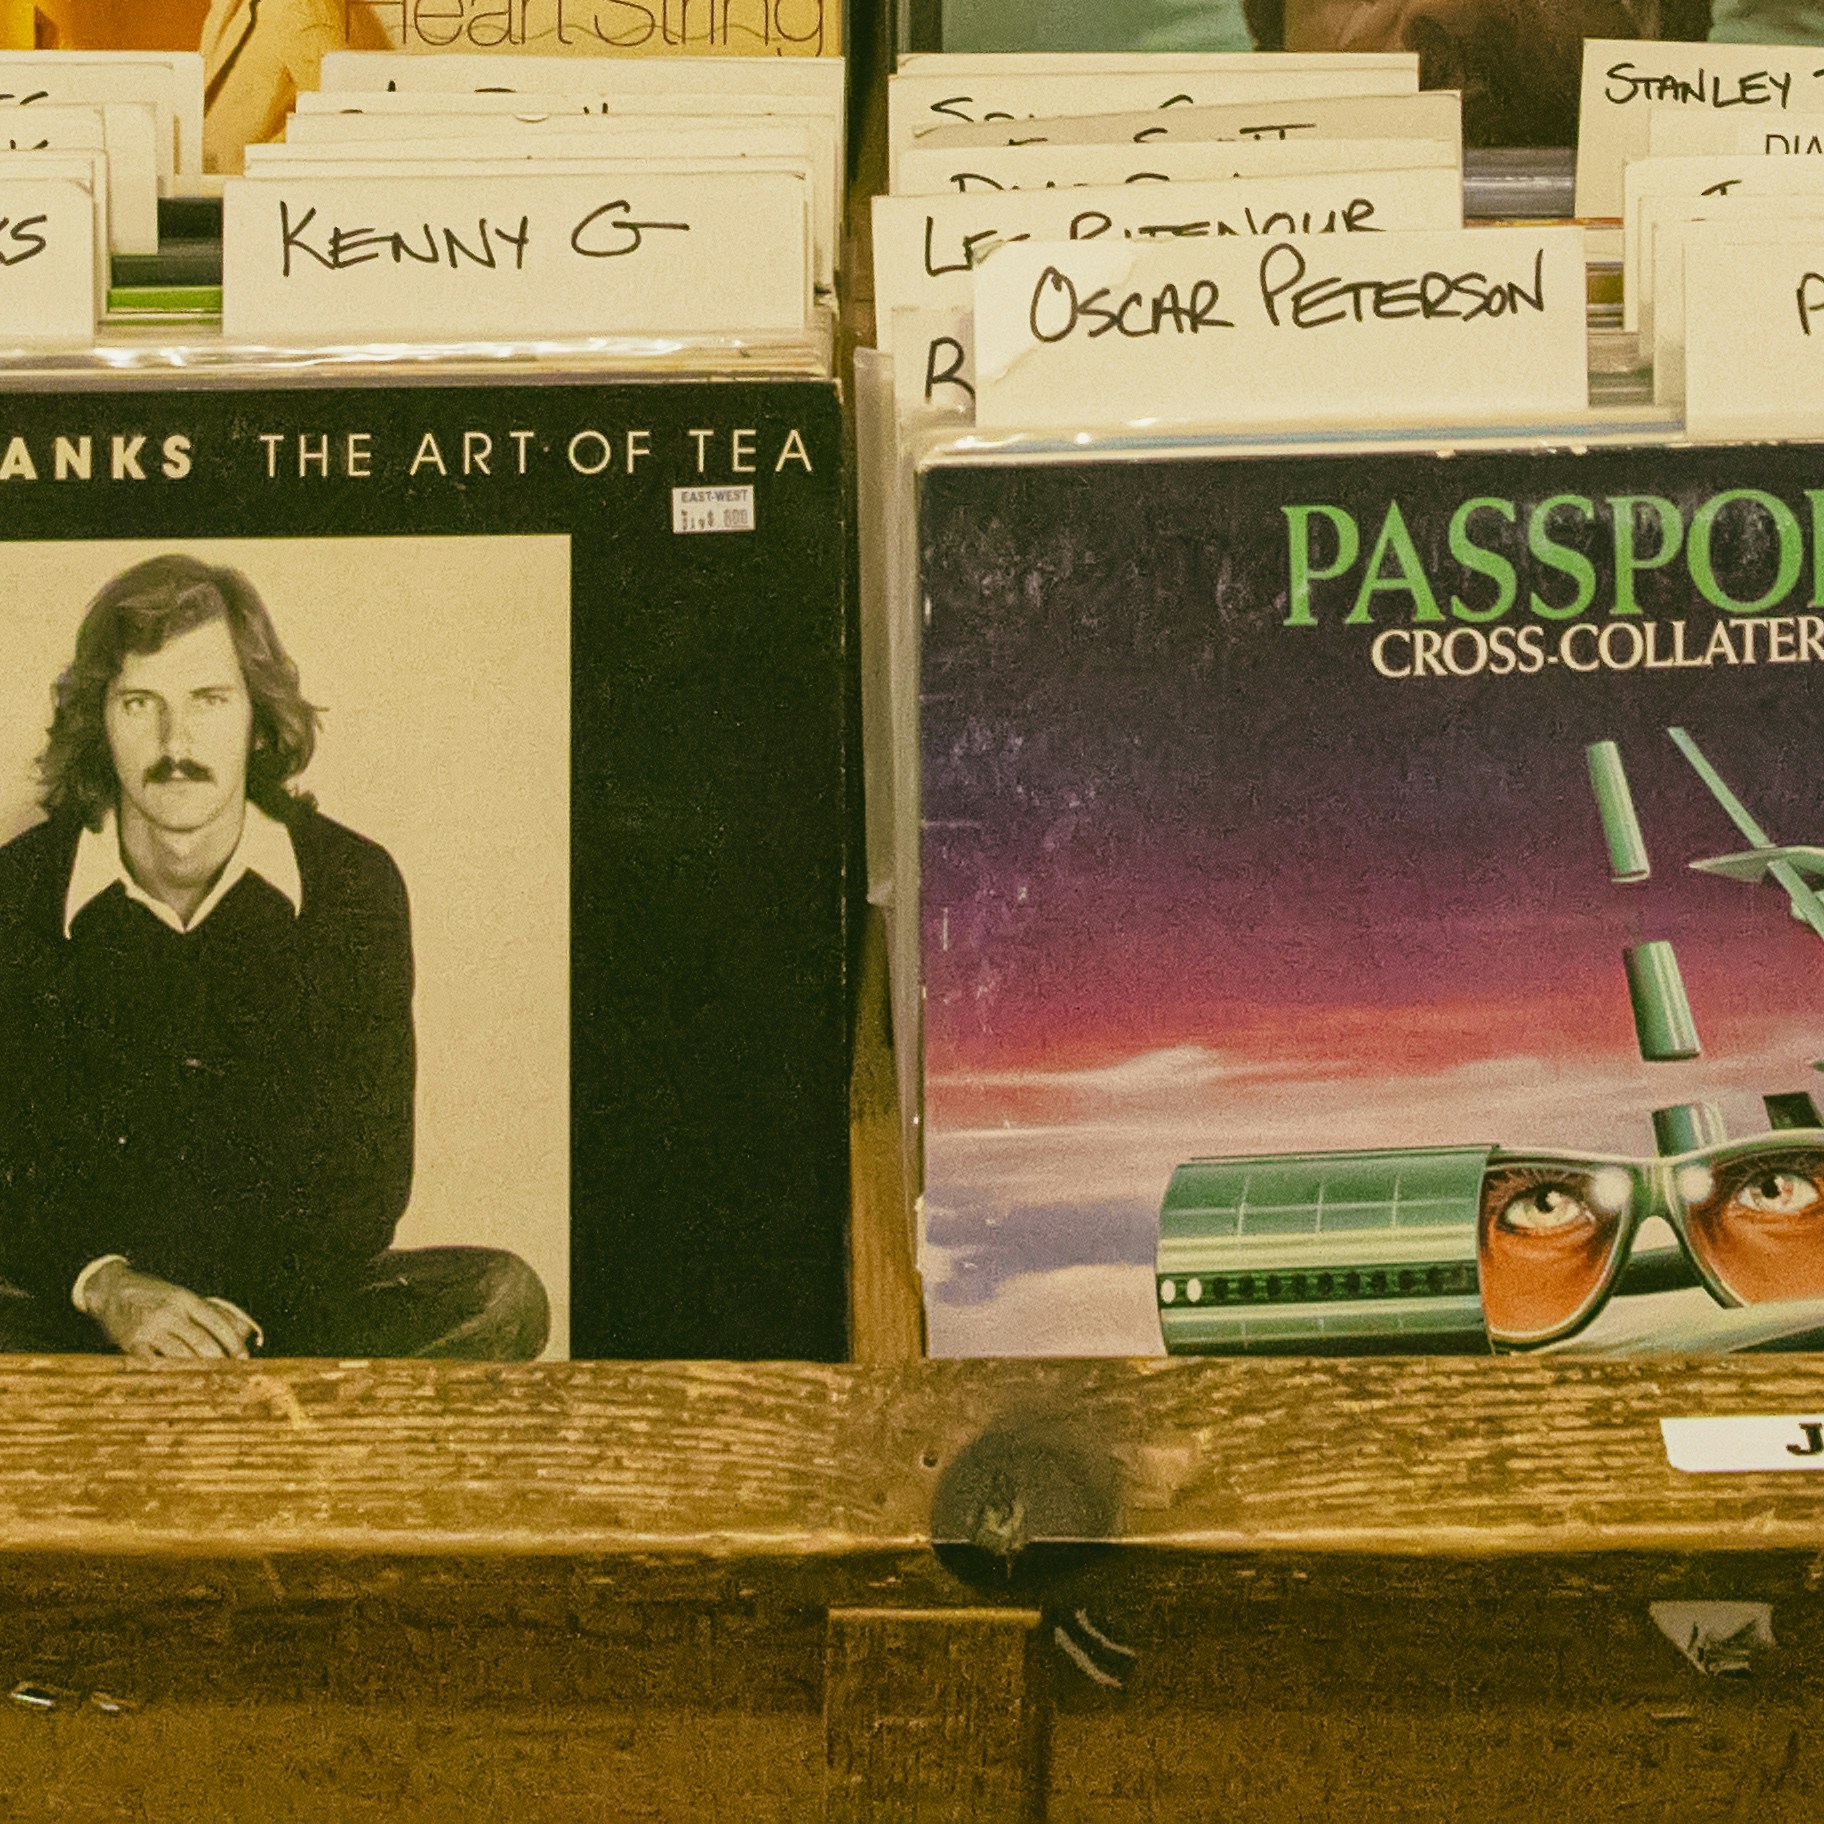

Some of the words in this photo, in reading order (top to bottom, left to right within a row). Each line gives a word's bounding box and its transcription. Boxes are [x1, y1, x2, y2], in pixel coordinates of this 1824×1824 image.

[1604, 63, 1791, 109] STANLEY
[279, 201, 532, 276] KENNY
[569, 201, 691, 261] G
[1030, 265, 1235, 343] OSCAR
[1260, 243, 1547, 330] PETERSON
[259, 431, 374, 478] THE
[408, 429, 536, 476] ART
[563, 428, 655, 475] OF
[686, 427, 816, 475] TEA
[680, 488, 749, 505] EAST-WEST
